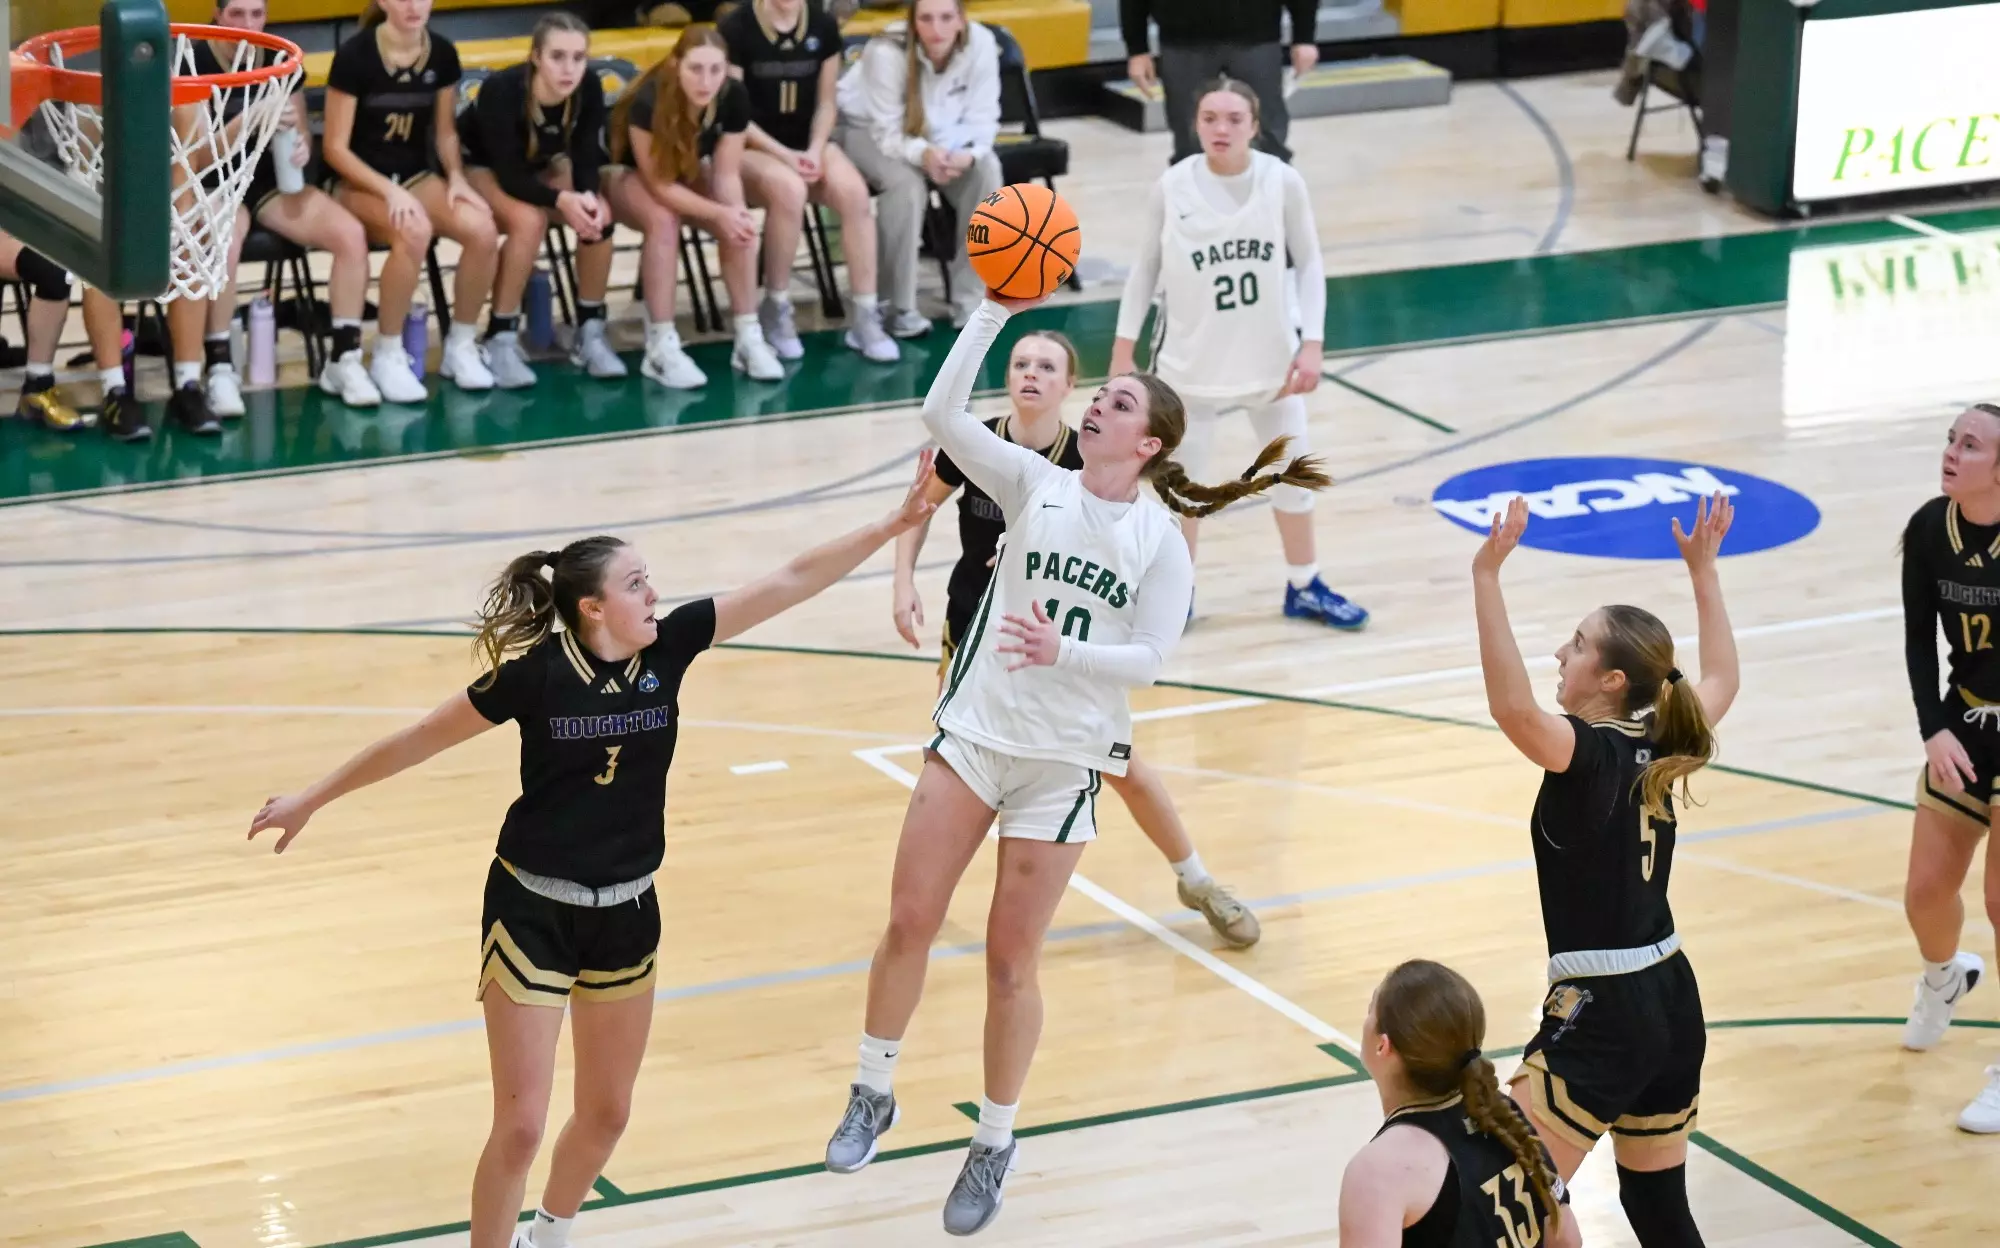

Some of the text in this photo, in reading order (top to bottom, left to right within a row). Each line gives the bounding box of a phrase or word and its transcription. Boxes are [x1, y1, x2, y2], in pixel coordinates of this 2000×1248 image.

[383, 112, 415, 141] 24
[1191, 238, 1275, 272] PACERS
[1213, 271, 1259, 311] 20
[1432, 467, 1741, 528] NCAA
[1025, 551, 1129, 609] PACERS
[1959, 611, 1994, 653] 12
[549, 705, 669, 739] HOUGHTON
[593, 744, 623, 785] 3
[1639, 803, 1657, 883] 5
[1479, 1162, 1541, 1248] 33
